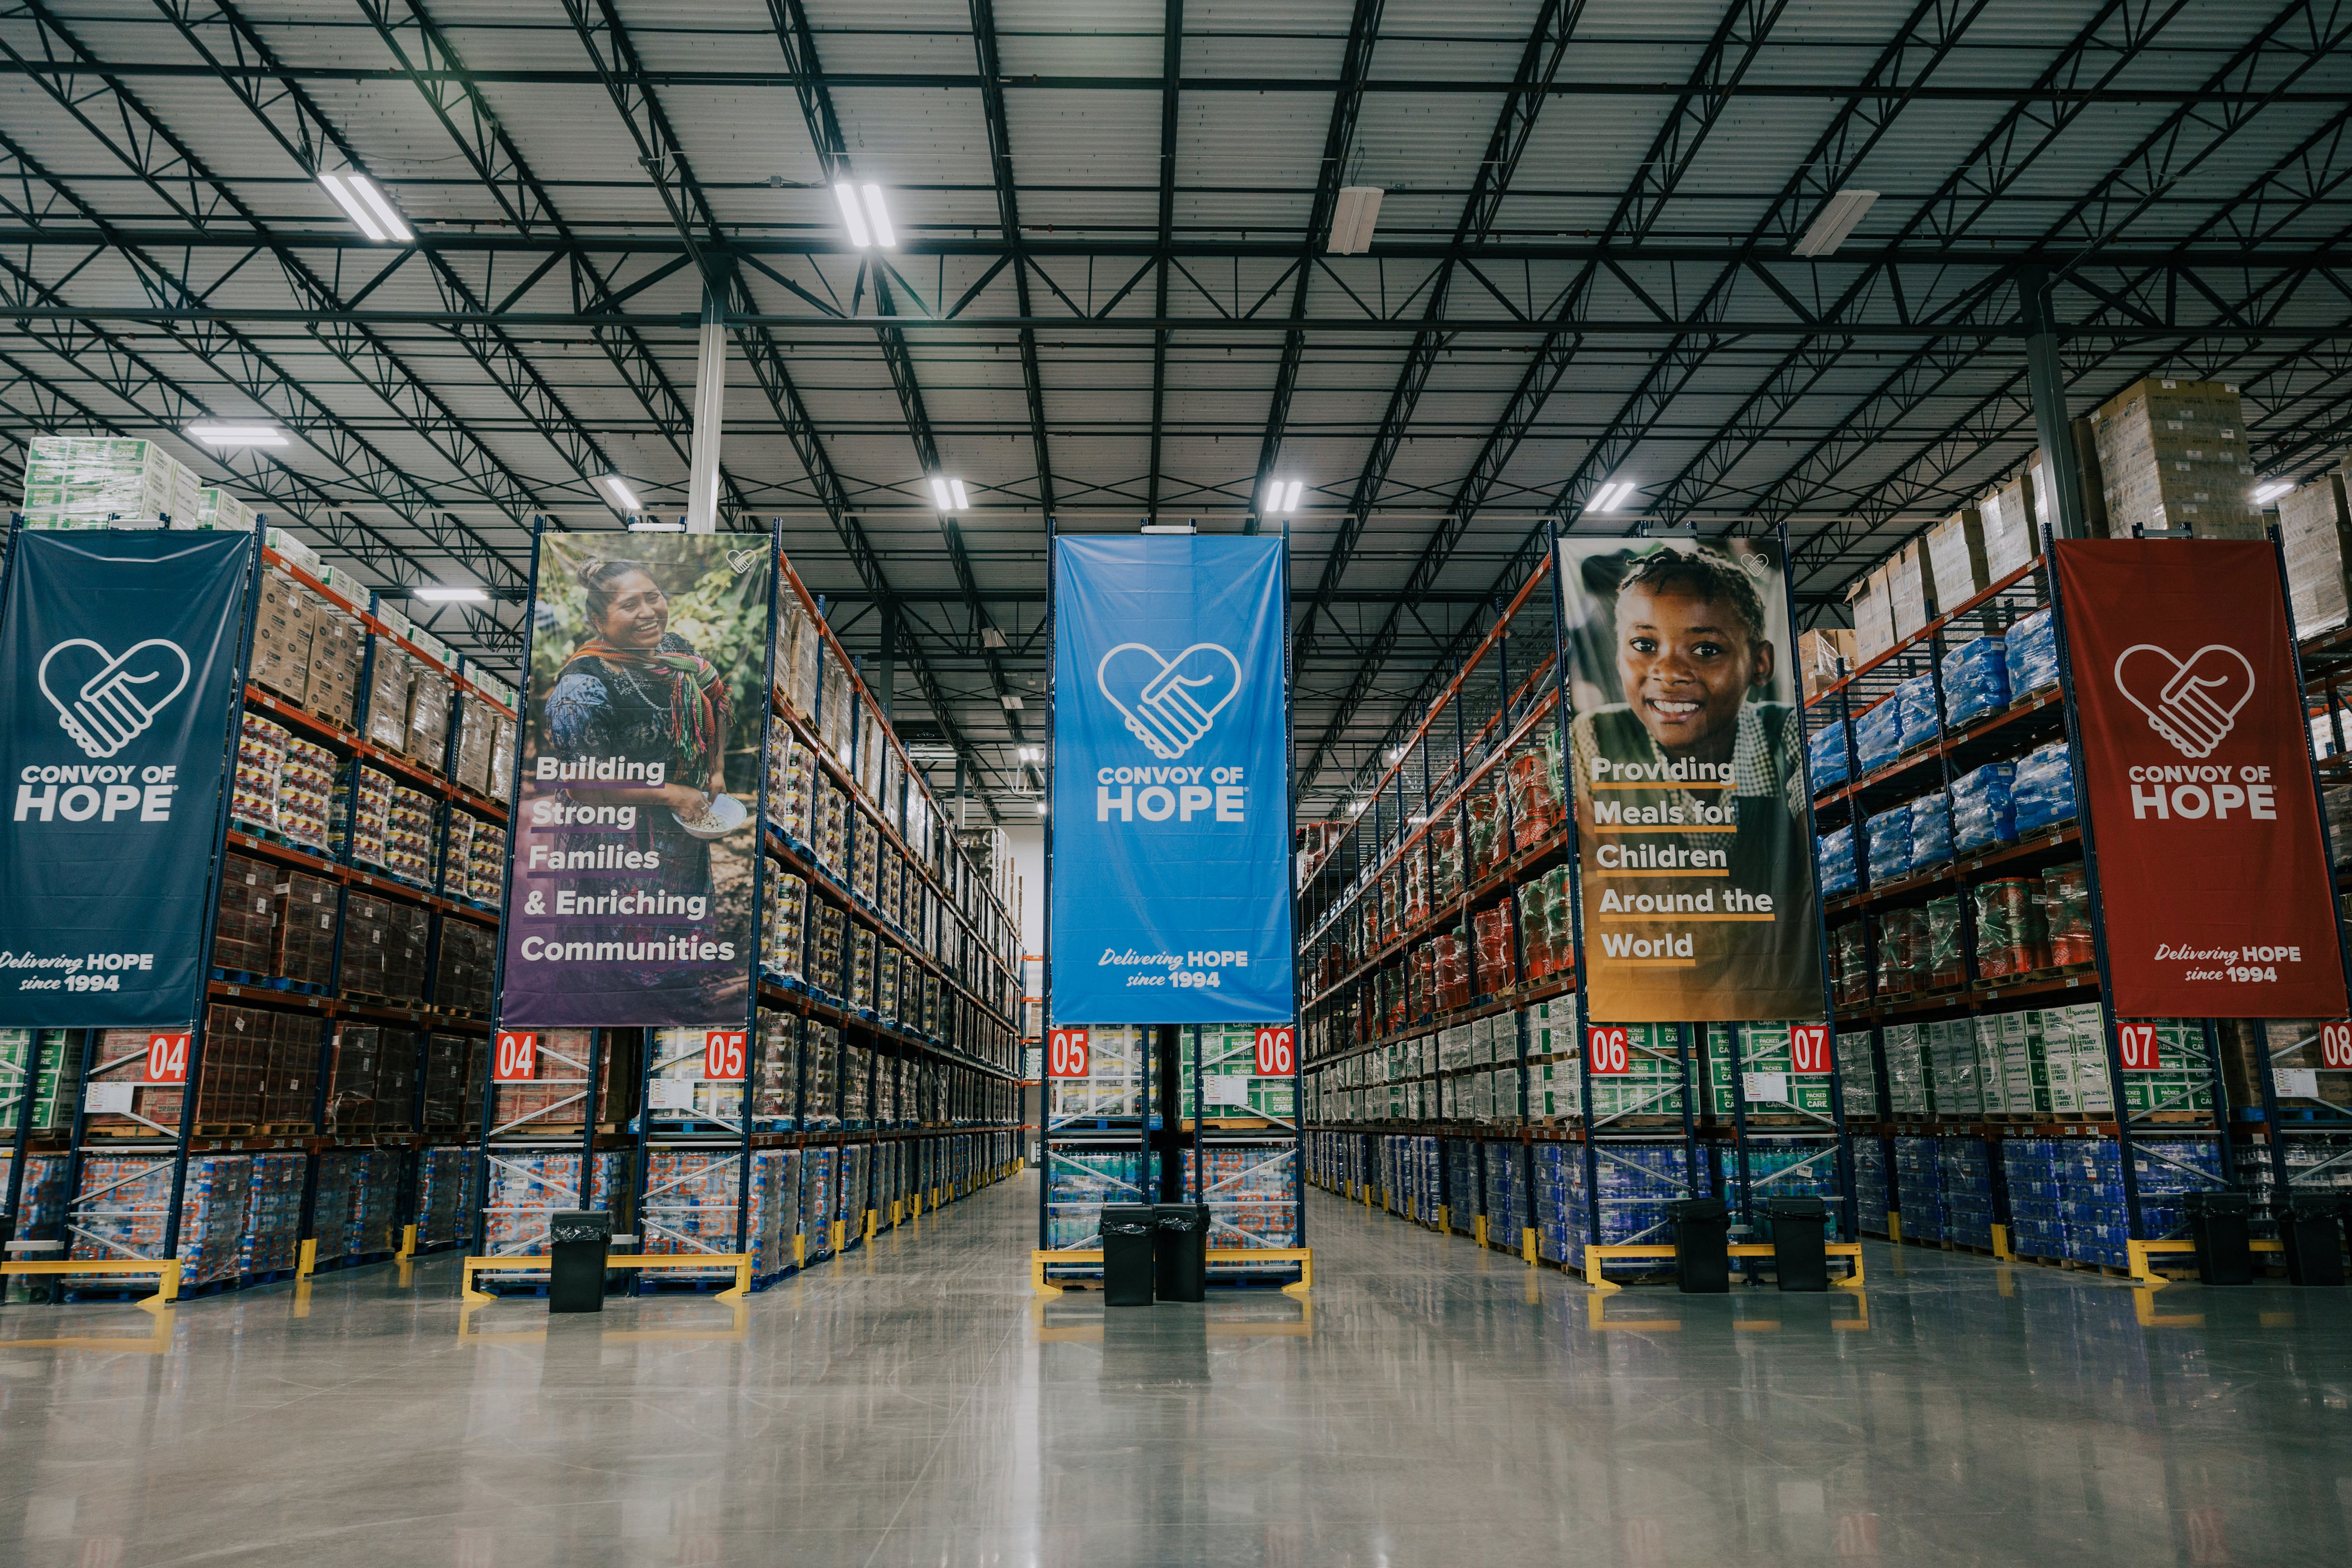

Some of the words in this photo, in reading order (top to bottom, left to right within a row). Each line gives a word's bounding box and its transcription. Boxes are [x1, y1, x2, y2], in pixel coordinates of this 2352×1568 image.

[21, 766, 131, 783] CONVOY
[141, 766, 177, 783] OF
[536, 754, 665, 786] Building
[1097, 767, 1205, 784] CONVOY
[1211, 767, 1244, 784] OF
[1591, 757, 1734, 786] Providing
[2129, 766, 2232, 783] CONVOY
[2240, 766, 2271, 783] OF
[532, 801, 636, 830] Strong
[1594, 801, 1684, 824] Meals
[1692, 800, 1735, 823] for
[528, 844, 660, 870] Families
[1596, 844, 1727, 868] Children
[524, 890, 546, 915] &
[556, 889, 706, 920] Enriching
[1599, 889, 1714, 913] Around
[1722, 889, 1773, 912] the
[521, 935, 735, 961] Communities
[1600, 933, 1693, 957] World
[2154, 943, 2239, 965] Delivering
[2242, 946, 2302, 962] HOPE
[0, 951, 84, 974] Delivering
[87, 953, 154, 970] HOPE
[1098, 948, 1184, 971] Delivering
[1188, 951, 1248, 967] HOPE
[18, 975, 62, 991] since
[64, 975, 120, 991] 1994
[1126, 972, 1165, 987] since
[1168, 971, 1221, 988] 1994
[2185, 967, 2223, 981] since
[2226, 966, 2278, 983] 1994
[150, 1037, 186, 1079] 04
[499, 1036, 532, 1077] 04
[709, 1035, 742, 1076] 05
[1052, 1033, 1085, 1074] 05
[1259, 1032, 1291, 1073] 06
[1593, 1030, 1625, 1071] 06
[1794, 1029, 1824, 1069] 07
[2122, 1026, 2153, 1066] 07
[2324, 1026, 2352, 1066] 08
